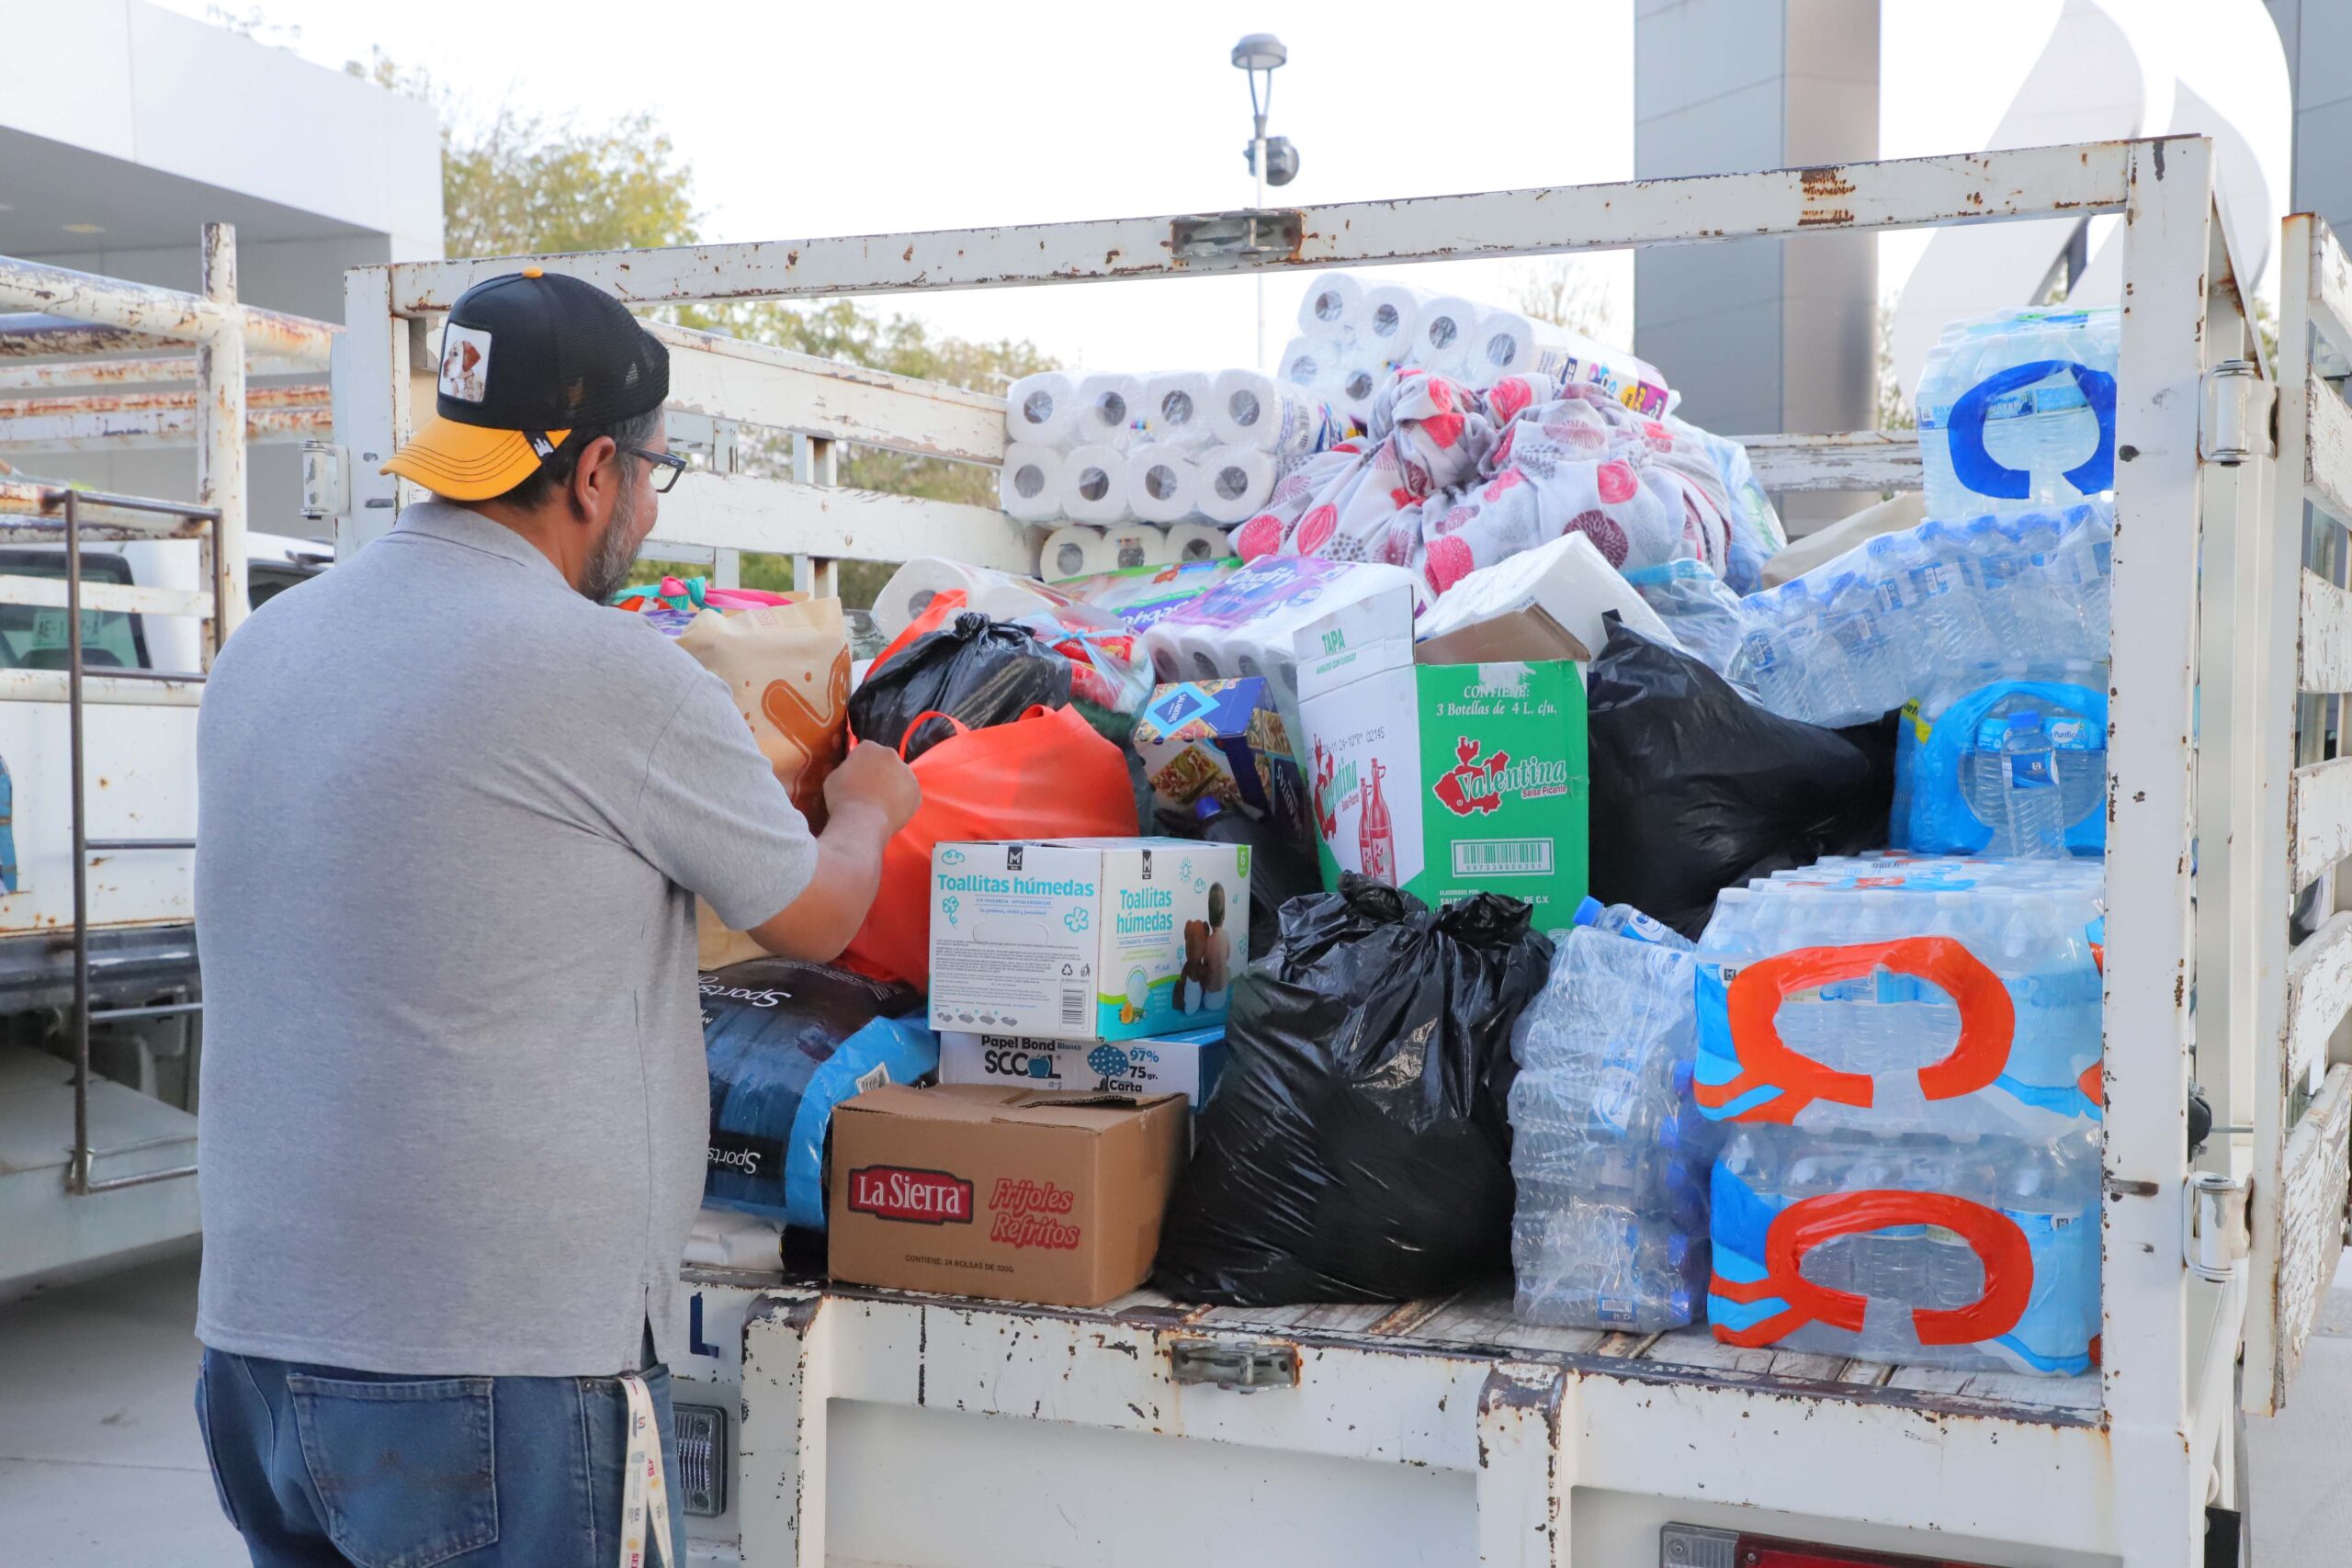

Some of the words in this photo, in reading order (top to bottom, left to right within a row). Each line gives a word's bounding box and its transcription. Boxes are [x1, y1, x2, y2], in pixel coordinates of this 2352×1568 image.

[1321, 627, 1346, 656] TAPA
[1436, 704, 1444, 716] 3
[1448, 700, 1489, 716] Botellas
[1493, 700, 1506, 715] de
[1512, 702, 1520, 715] 4
[1522, 702, 1534, 715] L.
[1538, 699, 1558, 716] c/u.
[1455, 755, 1567, 803] Valentina
[1522, 787, 1542, 798] Salsa
[1543, 785, 1566, 796] Picante
[1240, 852, 1246, 865] 6
[937, 874, 1010, 894] Toallitas
[1013, 876, 1095, 897] húmedas
[1119, 886, 1172, 910] Toallitas
[1524, 896, 1533, 904] DE
[1535, 895, 1550, 904] C.V.
[1116, 910, 1173, 934] húmedas
[981, 1034, 1018, 1049] Papel
[1022, 1036, 1056, 1052] Bond
[1057, 1042, 1081, 1052] Blanco
[1129, 1049, 1159, 1063] 97%
[1128, 1066, 1148, 1078] 75
[1148, 1072, 1159, 1080] gr.
[1109, 1079, 1142, 1093] Carta
[858, 1176, 886, 1207] La
[888, 1172, 961, 1214] Sierra
[989, 1178, 1074, 1217] Frijoles
[990, 1213, 1080, 1249] Refritos
[954, 1259, 983, 1269] BOLSAS
[985, 1263, 995, 1271] DE
[690, 1292, 719, 1359] L
